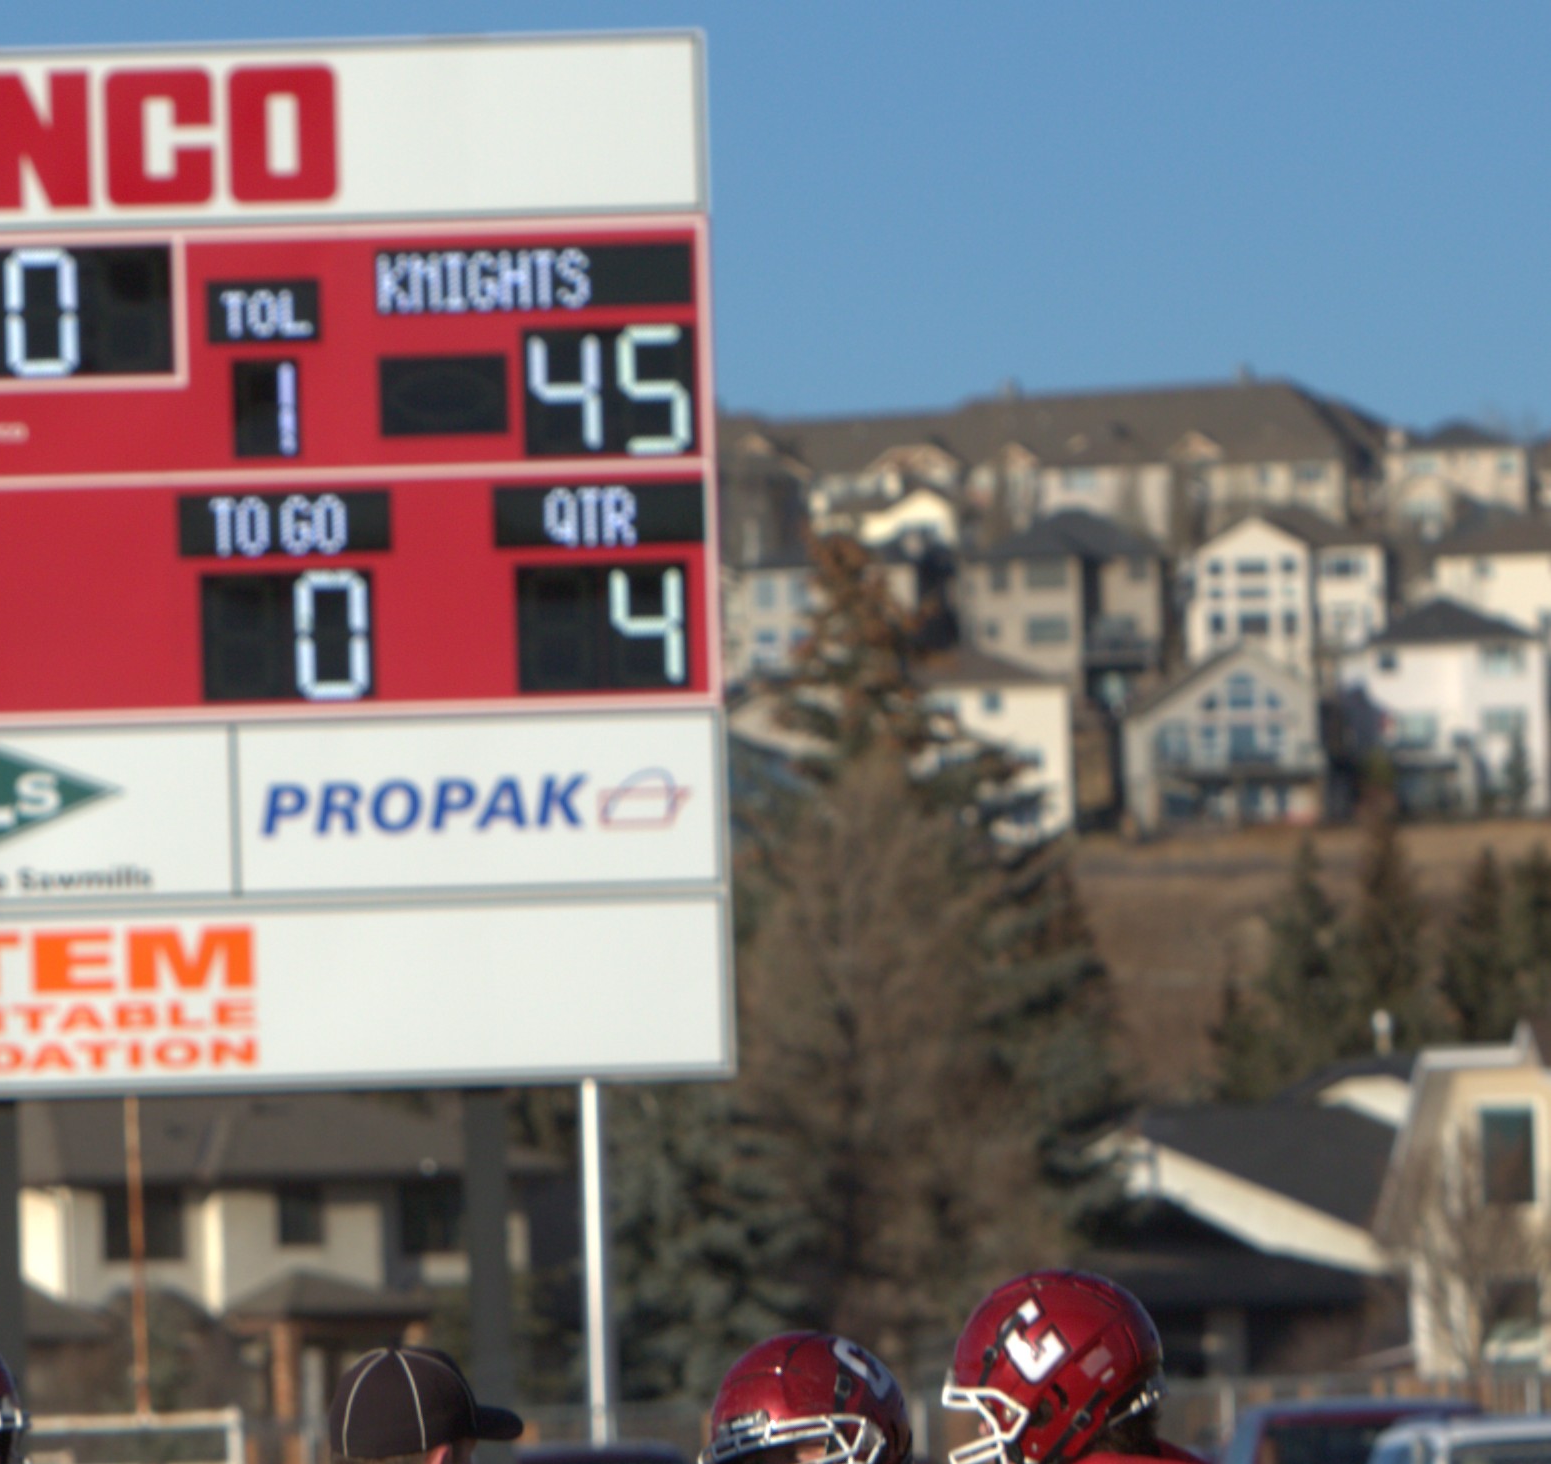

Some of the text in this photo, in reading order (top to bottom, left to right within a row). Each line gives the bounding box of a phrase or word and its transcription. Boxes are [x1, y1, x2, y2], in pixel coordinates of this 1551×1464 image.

[220, 290, 313, 337] TOL
[376, 249, 590, 315] KNIGHTS
[276, 361, 299, 457] 1
[526, 325, 690, 455] 45
[210, 495, 347, 557] TO GO
[544, 487, 637, 547] QTR
[295, 568, 369, 699] 0
[608, 568, 685, 683] 4
[260, 772, 588, 837] PROPAK
[18, 864, 154, 891] Sawmills
